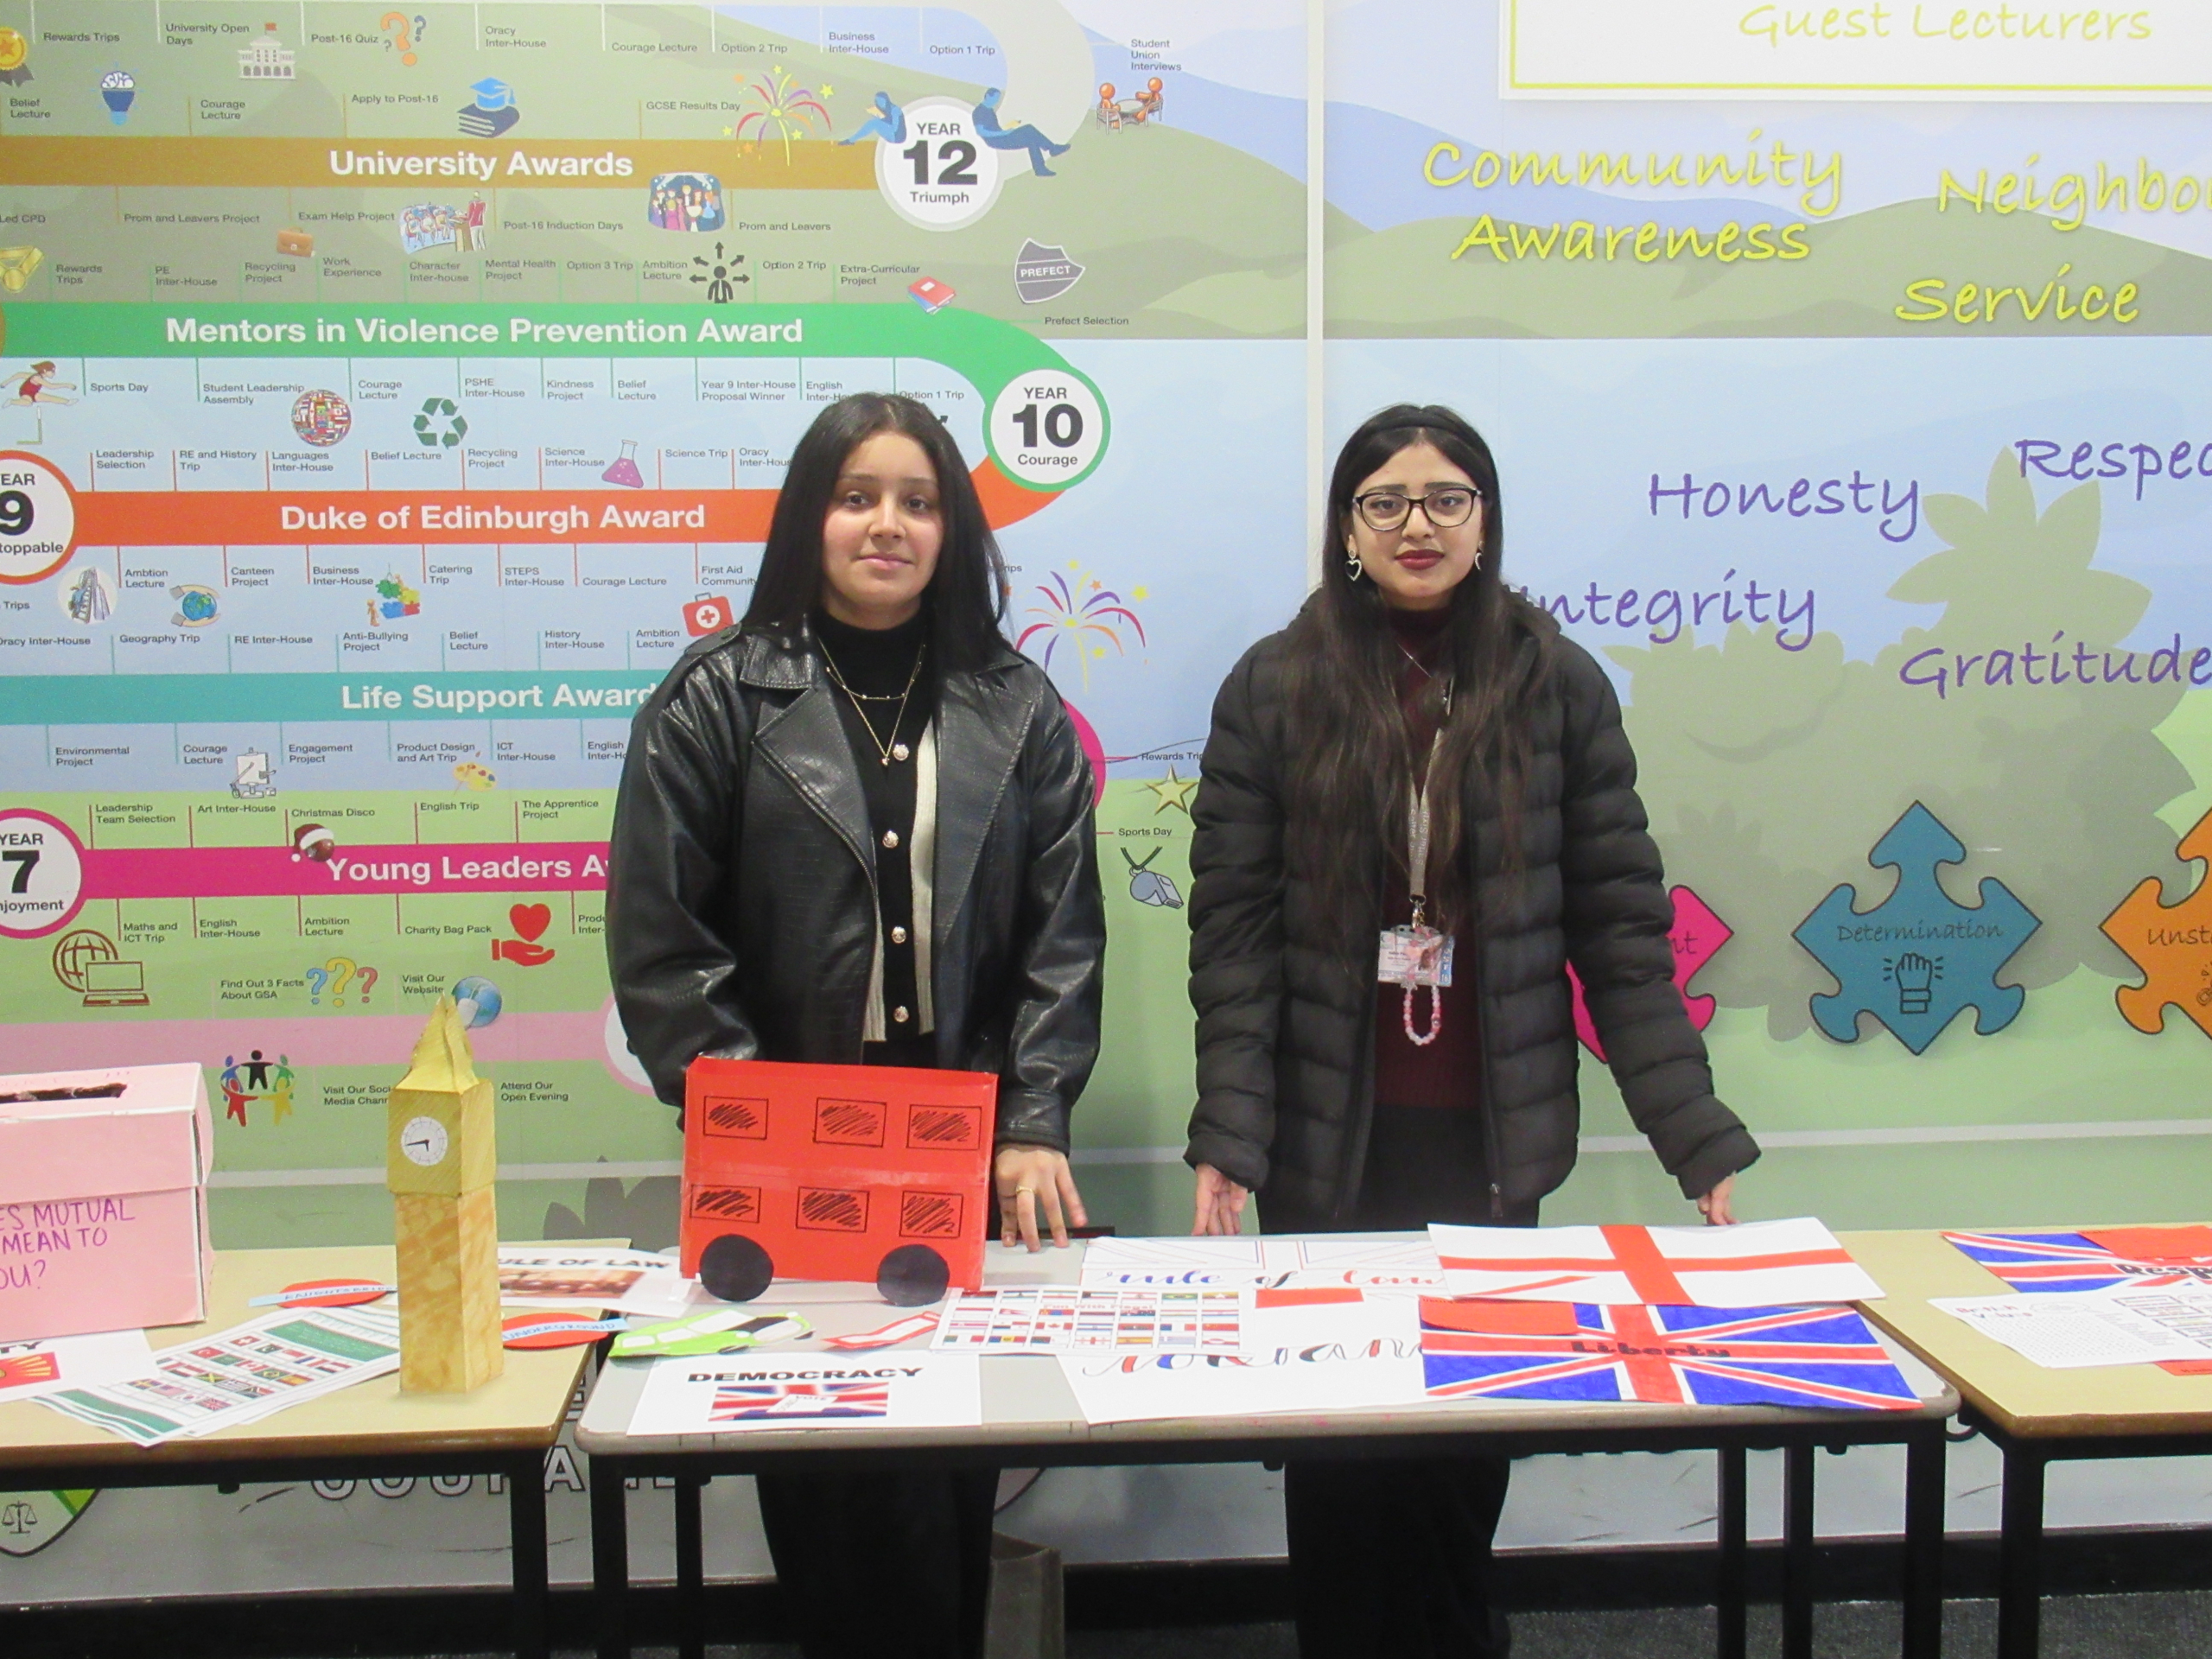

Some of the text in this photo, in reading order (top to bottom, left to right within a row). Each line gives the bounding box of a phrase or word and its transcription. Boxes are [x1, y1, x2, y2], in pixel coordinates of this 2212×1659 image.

[165, 22, 250, 35] University Open
[1738, 3, 2153, 47] Guest Lecturers
[166, 35, 193, 47] Days
[310, 33, 378, 44] Post-16 Quiz
[828, 31, 876, 41] Business
[611, 41, 699, 54] Courage Lecture
[1130, 38, 1171, 48] Student
[828, 44, 891, 55] Inter-House
[929, 44, 996, 57] Option 1 Trip
[1130, 50, 1160, 60] Union
[1130, 61, 1182, 72] Interviews
[351, 93, 440, 105] Apply to Post-16
[645, 100, 741, 112] GCSE Results Day
[917, 123, 960, 135] YEAR
[330, 150, 632, 181] University Awards
[903, 141, 978, 185] 12
[1423, 130, 1842, 215] Community
[1939, 153, 2212, 231] Neighbo
[910, 192, 969, 205] Triumph
[123, 212, 260, 225] Prom and Leavers Project
[503, 220, 625, 232] Post-16 Induction Days
[739, 221, 832, 232] Prom and Leavers
[1452, 214, 1812, 264] Awareness
[839, 264, 920, 274] Extra-Curricular
[1021, 266, 1071, 279] PREFECT
[840, 276, 877, 287] Project
[1895, 263, 2139, 323] Service
[1044, 315, 1129, 326] Prefect Selection
[165, 317, 802, 342] Mentors in Violence Prevention Award
[90, 382, 149, 394] Sports Day
[463, 378, 494, 387] PSHE
[701, 380, 797, 390] Year 9 Inter-House
[202, 383, 305, 395] Student Leadership
[464, 388, 525, 397] Inter-House
[1024, 387, 1066, 399] YEAR
[203, 395, 254, 406] Assembly
[702, 391, 785, 403] Proposal Winner
[1013, 404, 1083, 448] 10
[179, 449, 257, 461] RE and History
[271, 451, 330, 462] Languages
[664, 448, 729, 460] Science Trip
[1018, 454, 1077, 467] Courage
[180, 461, 201, 473] Trip
[272, 462, 334, 472] Inter-House
[2015, 439, 2212, 501] Respec
[1, 474, 35, 486] EAR
[0, 491, 34, 535] 9
[1649, 471, 1919, 543] Honesty
[282, 505, 704, 534] Duke of Edinburgh Award
[0, 543, 66, 556] toppable
[428, 564, 474, 575] Catering
[504, 566, 540, 576] STEPS
[124, 579, 165, 588] Lecture
[429, 575, 450, 586] Trip
[505, 577, 565, 587] Inter-House
[1519, 569, 1815, 652] ntegrity
[119, 633, 200, 645] Geography Trip
[342, 631, 409, 642] Anti-Bullying
[343, 642, 380, 653] Project
[1899, 630, 2212, 700] Gratitude
[343, 686, 401, 708] Life
[413, 685, 543, 713] Support
[54, 746, 130, 756] Environmental
[397, 742, 476, 753] Product Design
[55, 757, 93, 768] Project
[397, 753, 458, 763] and Art Trip
[522, 799, 600, 810] The Apprentice
[290, 807, 376, 817] Christmas Disco
[522, 810, 559, 821] Project
[1118, 827, 1173, 837] Sports Day
[0, 834, 43, 845] YEAR
[3, 850, 39, 893] 7
[326, 858, 431, 885] Young
[442, 856, 571, 879] Leaders
[123, 922, 178, 931] Maths and
[404, 925, 493, 937] Charity Bag Pack
[1837, 919, 2003, 943] Determination
[124, 933, 165, 944] ICT Trip
[220, 978, 305, 988] Find Out 3 Facts
[402, 974, 445, 983] Visit Our
[220, 989, 278, 1000] About GSA
[402, 985, 445, 996] Website
[499, 1081, 553, 1090] Attend Our
[500, 1092, 569, 1103] Open Evening
[34, 1198, 136, 1229] MUTUAL
[3, 1227, 107, 1254] MEAN TO
[607, 1259, 669, 1268] LAW
[0, 1259, 46, 1289] OU?
[1571, 1341, 1731, 1358] Liberty
[688, 1368, 924, 1382] DEMOCRACY
